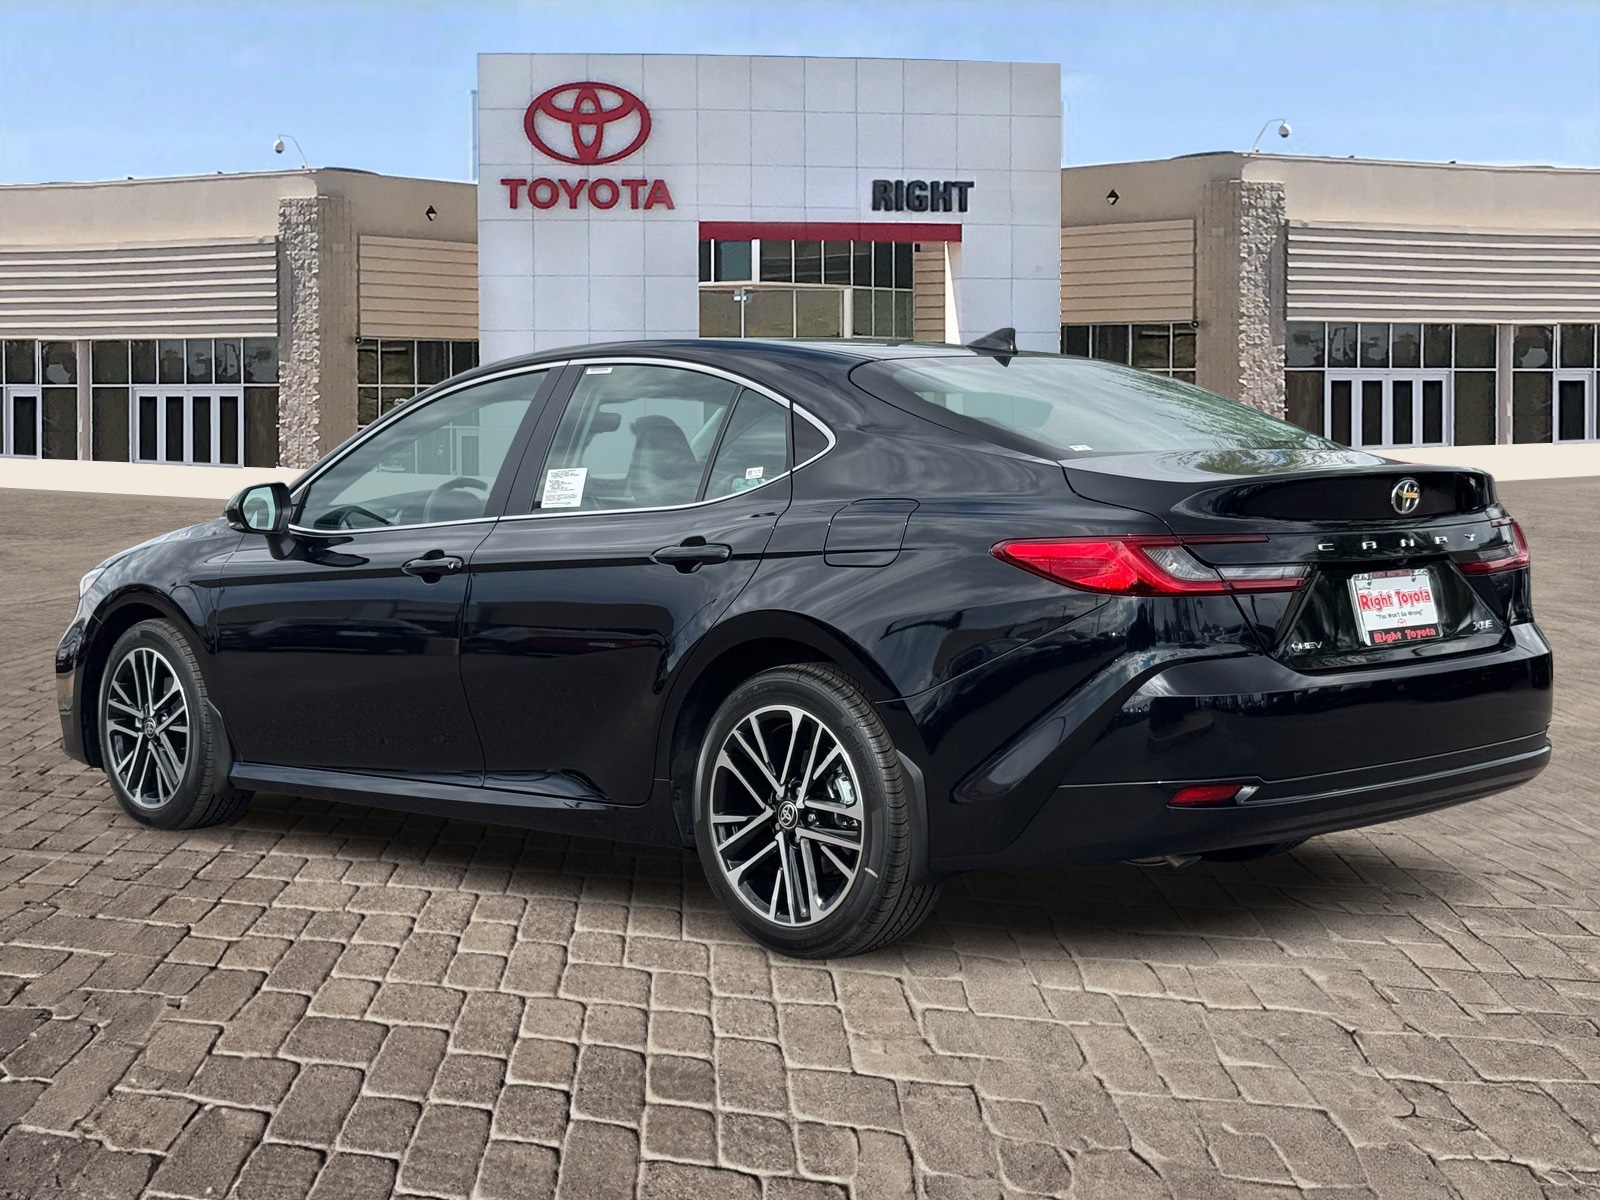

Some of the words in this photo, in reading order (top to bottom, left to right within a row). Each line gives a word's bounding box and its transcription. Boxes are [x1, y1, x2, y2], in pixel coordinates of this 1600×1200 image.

[500, 177, 675, 210] TOYOTA
[871, 179, 975, 212] RIGHT
[1317, 533, 1476, 551] CAMRY
[1358, 591, 1393, 612] Right
[1394, 588, 1431, 607] Toyota
[1373, 631, 1402, 643] Right
[1405, 628, 1436, 639] Toyota
[1472, 619, 1494, 631] XLE
